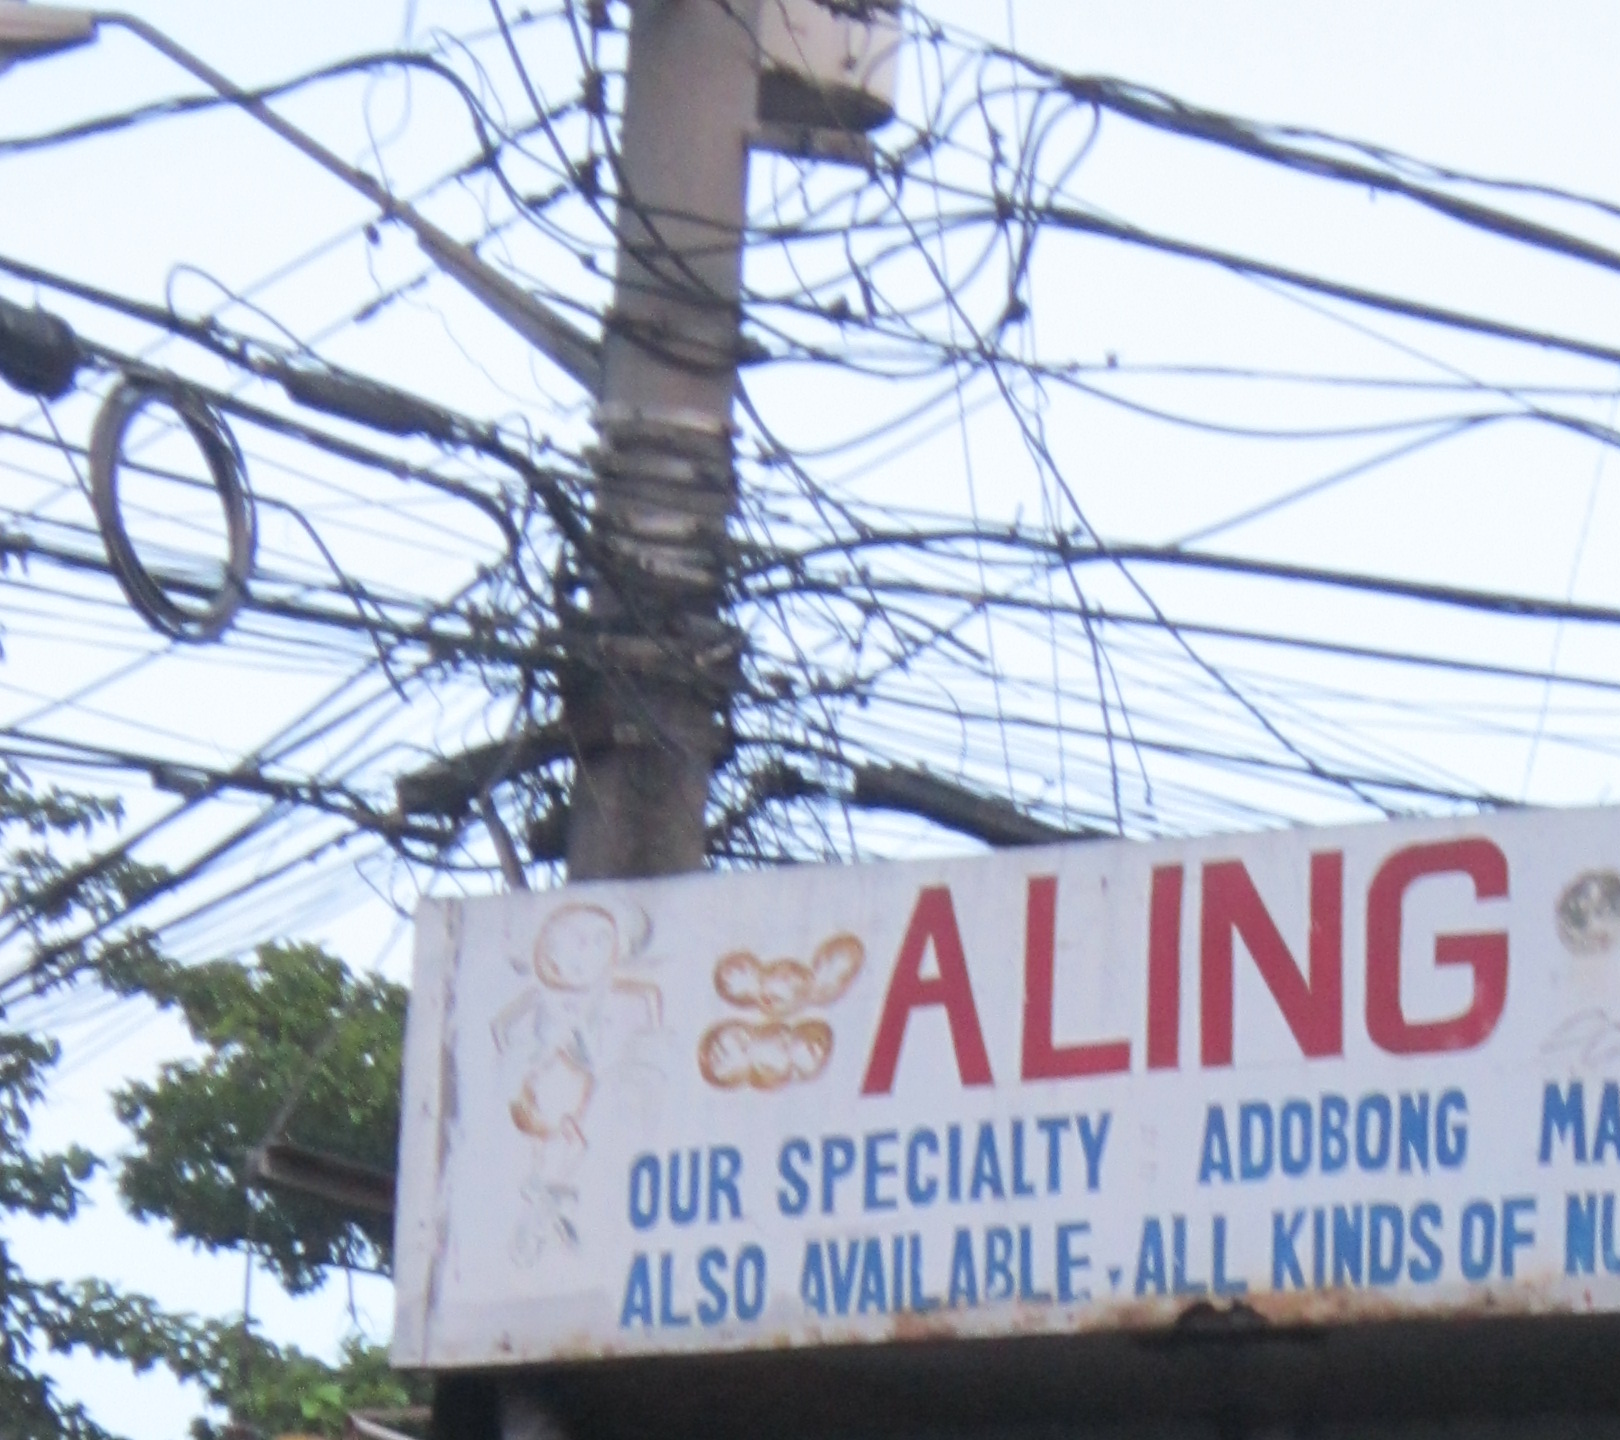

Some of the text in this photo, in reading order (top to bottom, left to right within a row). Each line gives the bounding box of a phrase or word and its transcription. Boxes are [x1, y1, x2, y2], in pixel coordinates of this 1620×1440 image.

[860, 837, 1510, 1096] ALING
[628, 1145, 745, 1232] OUR
[777, 1113, 1112, 1217] SPECIALTY
[1198, 1086, 1468, 1184] ADOBONG
[621, 1244, 768, 1330] ALSO
[1134, 1215, 1247, 1297] ALL
[1273, 1199, 1443, 1291] KINDS
[1461, 1198, 1536, 1281] OF
